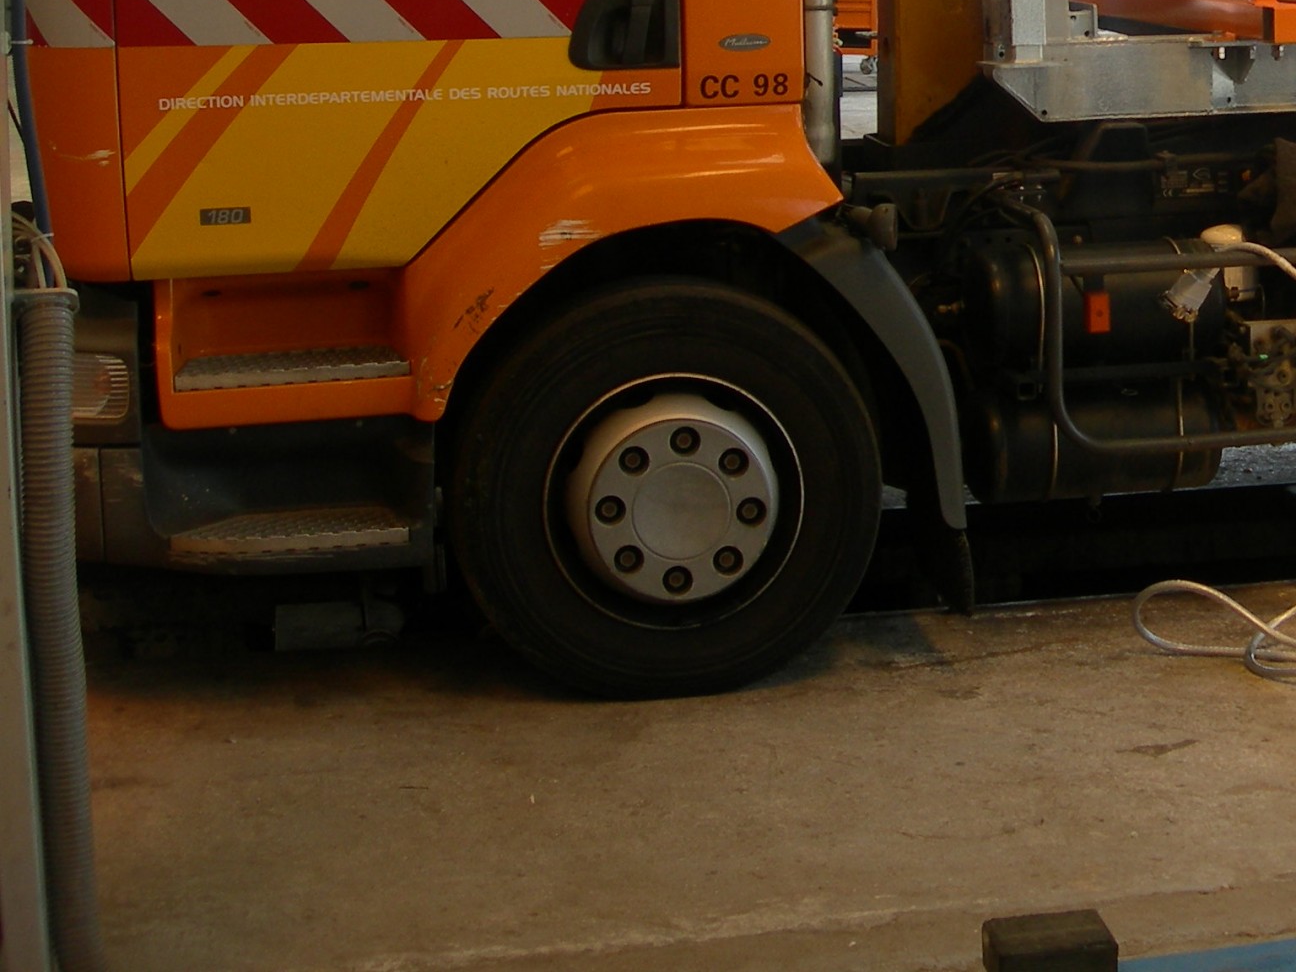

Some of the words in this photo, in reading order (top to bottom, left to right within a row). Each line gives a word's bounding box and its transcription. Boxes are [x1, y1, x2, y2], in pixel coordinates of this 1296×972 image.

[158, 95, 244, 111] DIRECTION
[249, 88, 443, 107] INTERDEPARTEMENTALE
[449, 87, 481, 100] DES
[487, 85, 550, 99] ROUTES
[556, 82, 651, 96] NATIONALES
[700, 74, 740, 99] CC
[753, 73, 788, 97] 98
[208, 209, 244, 224] 180
